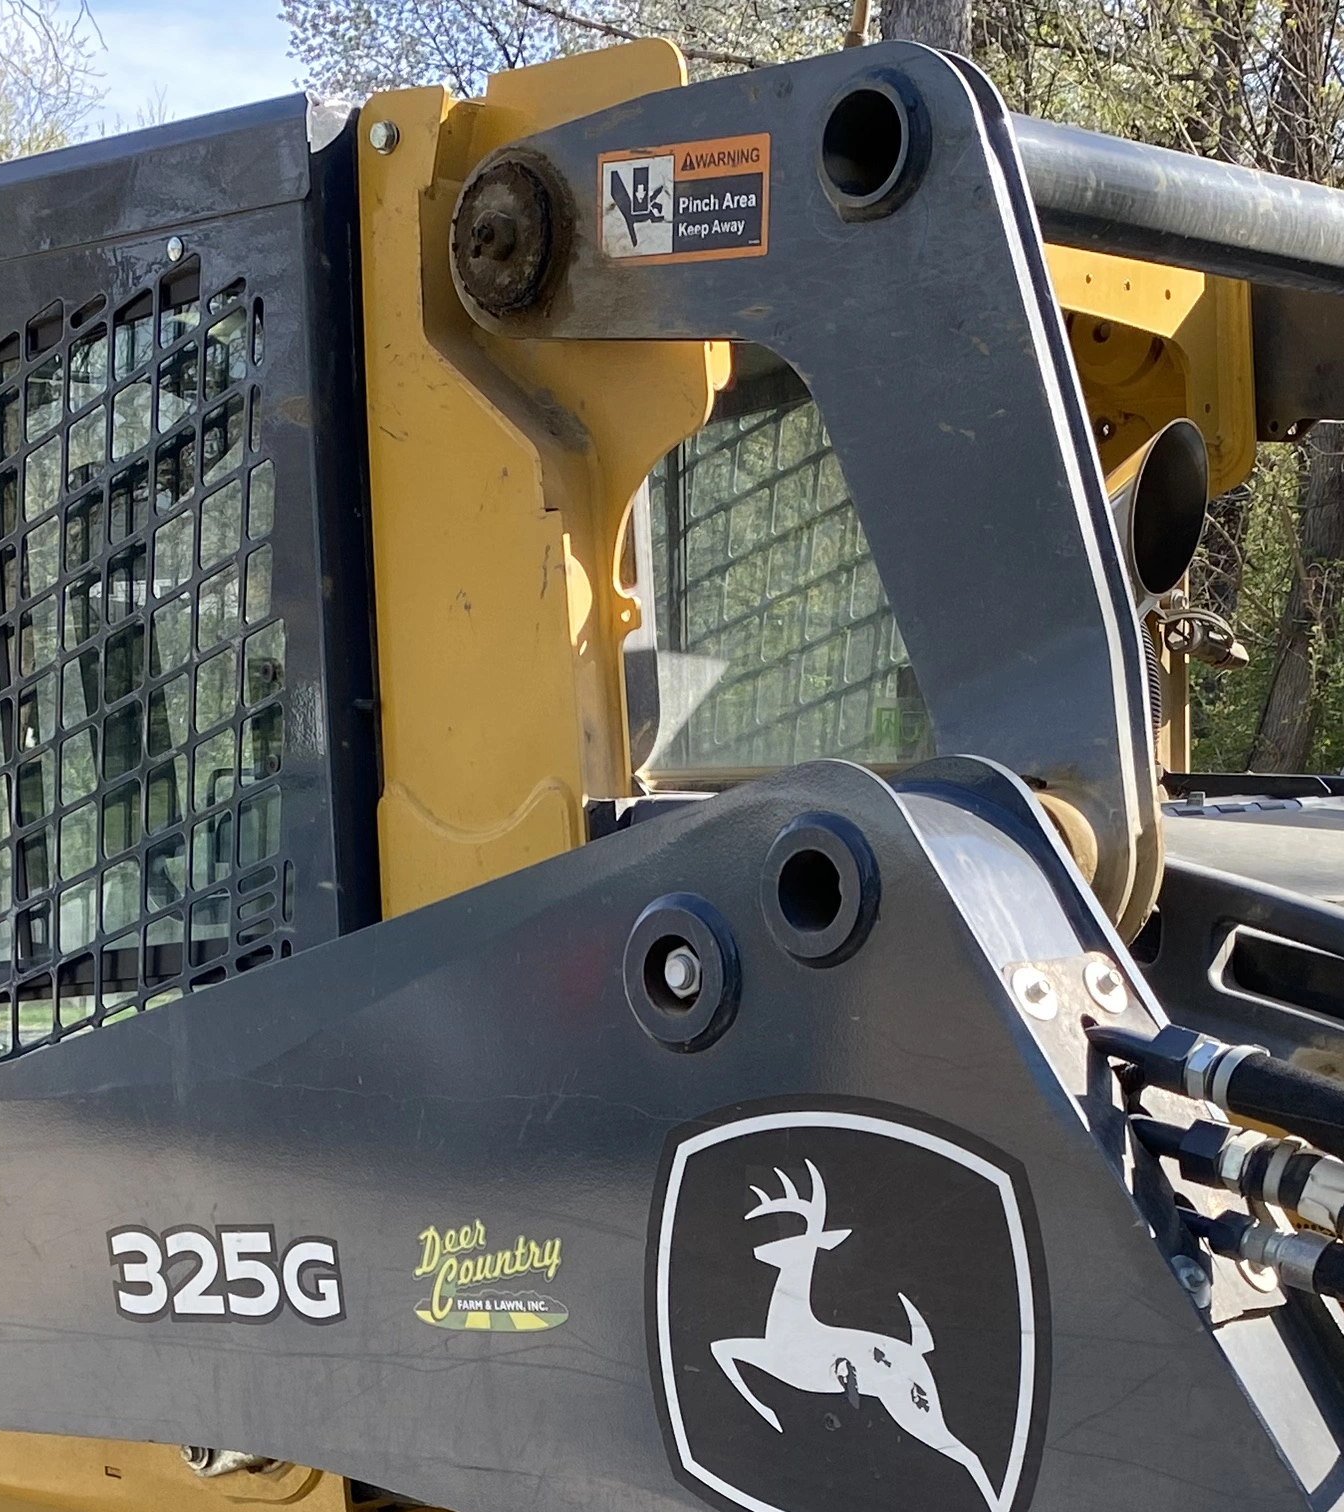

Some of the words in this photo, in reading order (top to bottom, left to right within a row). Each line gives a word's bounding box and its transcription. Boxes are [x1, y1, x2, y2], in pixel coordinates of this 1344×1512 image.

[695, 147, 760, 169] WARNING
[679, 193, 719, 214] Pinch
[722, 191, 757, 211] Area
[678, 222, 709, 239] Keep
[711, 219, 746, 236] Away
[414, 1217, 486, 1277] Deer
[110, 1230, 342, 1320] 325G
[431, 1235, 562, 1321] Country
[457, 1299, 484, 1311] FARM
[485, 1299, 493, 1311] &
[494, 1299, 527, 1313] LAWN,
[527, 1300, 549, 1312] INC.
